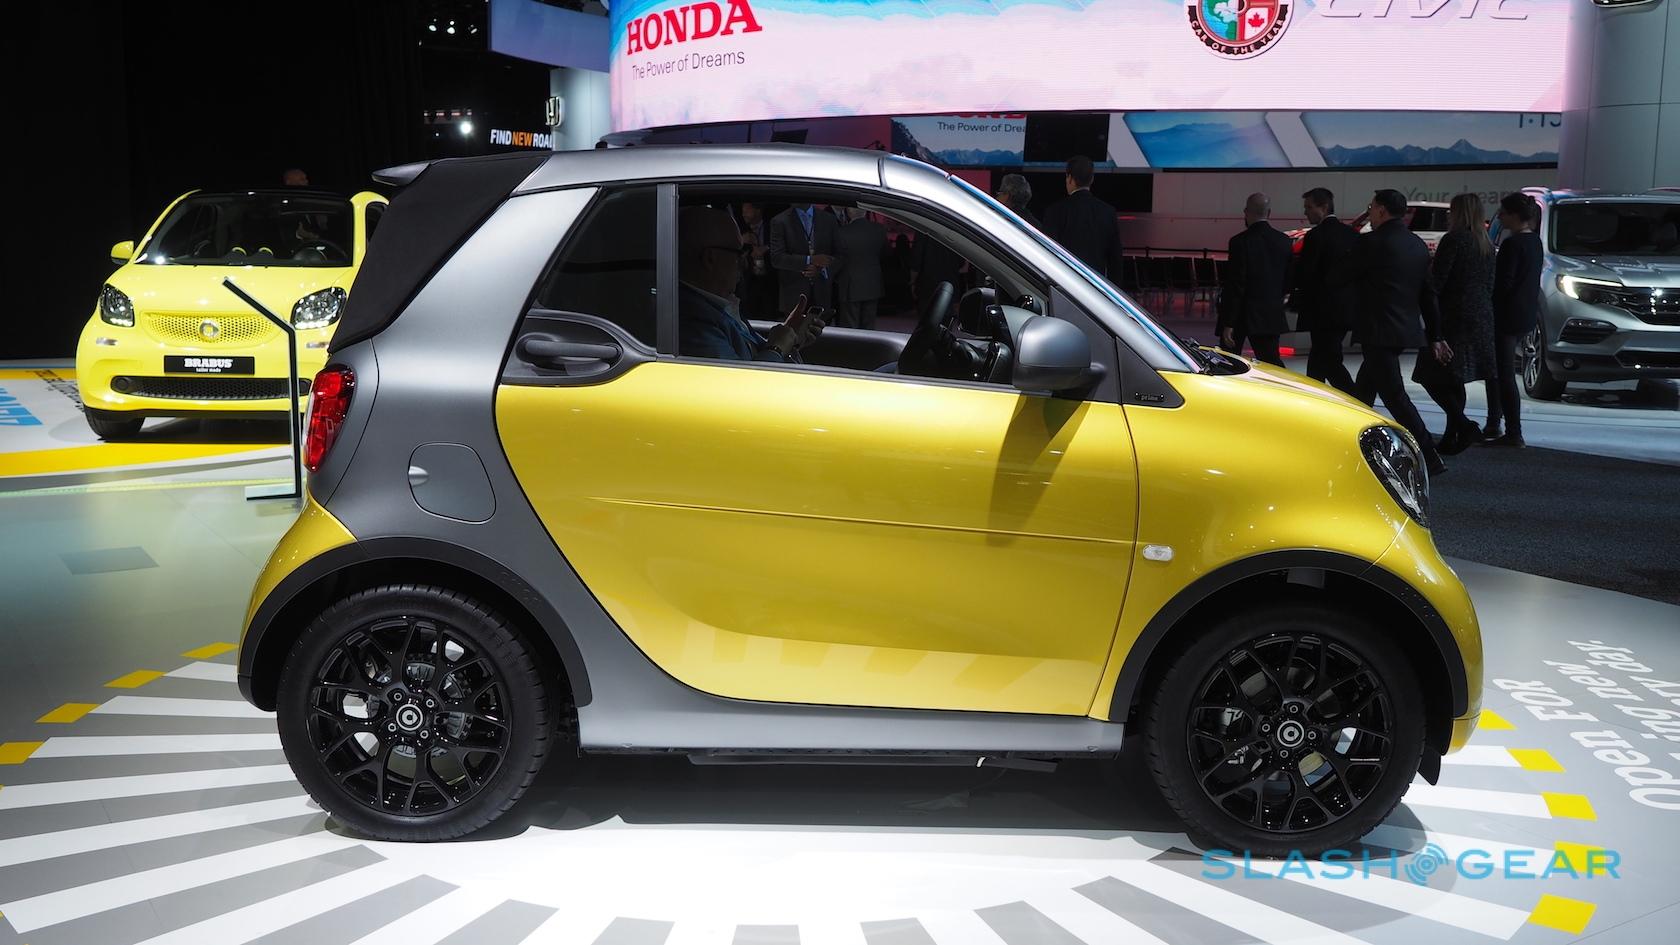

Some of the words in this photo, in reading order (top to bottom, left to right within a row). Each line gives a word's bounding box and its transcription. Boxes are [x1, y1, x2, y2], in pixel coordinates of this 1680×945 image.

[627, 0, 762, 55] HONDA
[1191, 20, 1208, 42] CAR
[1211, 42, 1227, 54] OF
[1233, 44, 1256, 55] THE
[1260, 19, 1285, 45] YEAR
[632, 64, 645, 80] The
[646, 60, 676, 77] Power
[677, 54, 689, 72] of
[692, 51, 746, 70] Dreams
[490, 129, 512, 145] FIND
[512, 131, 534, 147] NEW
[938, 121, 955, 131] The
[957, 122, 988, 132] Power
[990, 123, 1002, 133] of
[1004, 123, 1026, 133] Dre
[184, 358, 233, 368] BRABUS
[1567, 639, 1654, 673] day.
[1542, 660, 1645, 702] new
[1492, 678, 1600, 722] FOR
[1569, 730, 1680, 811] Open
